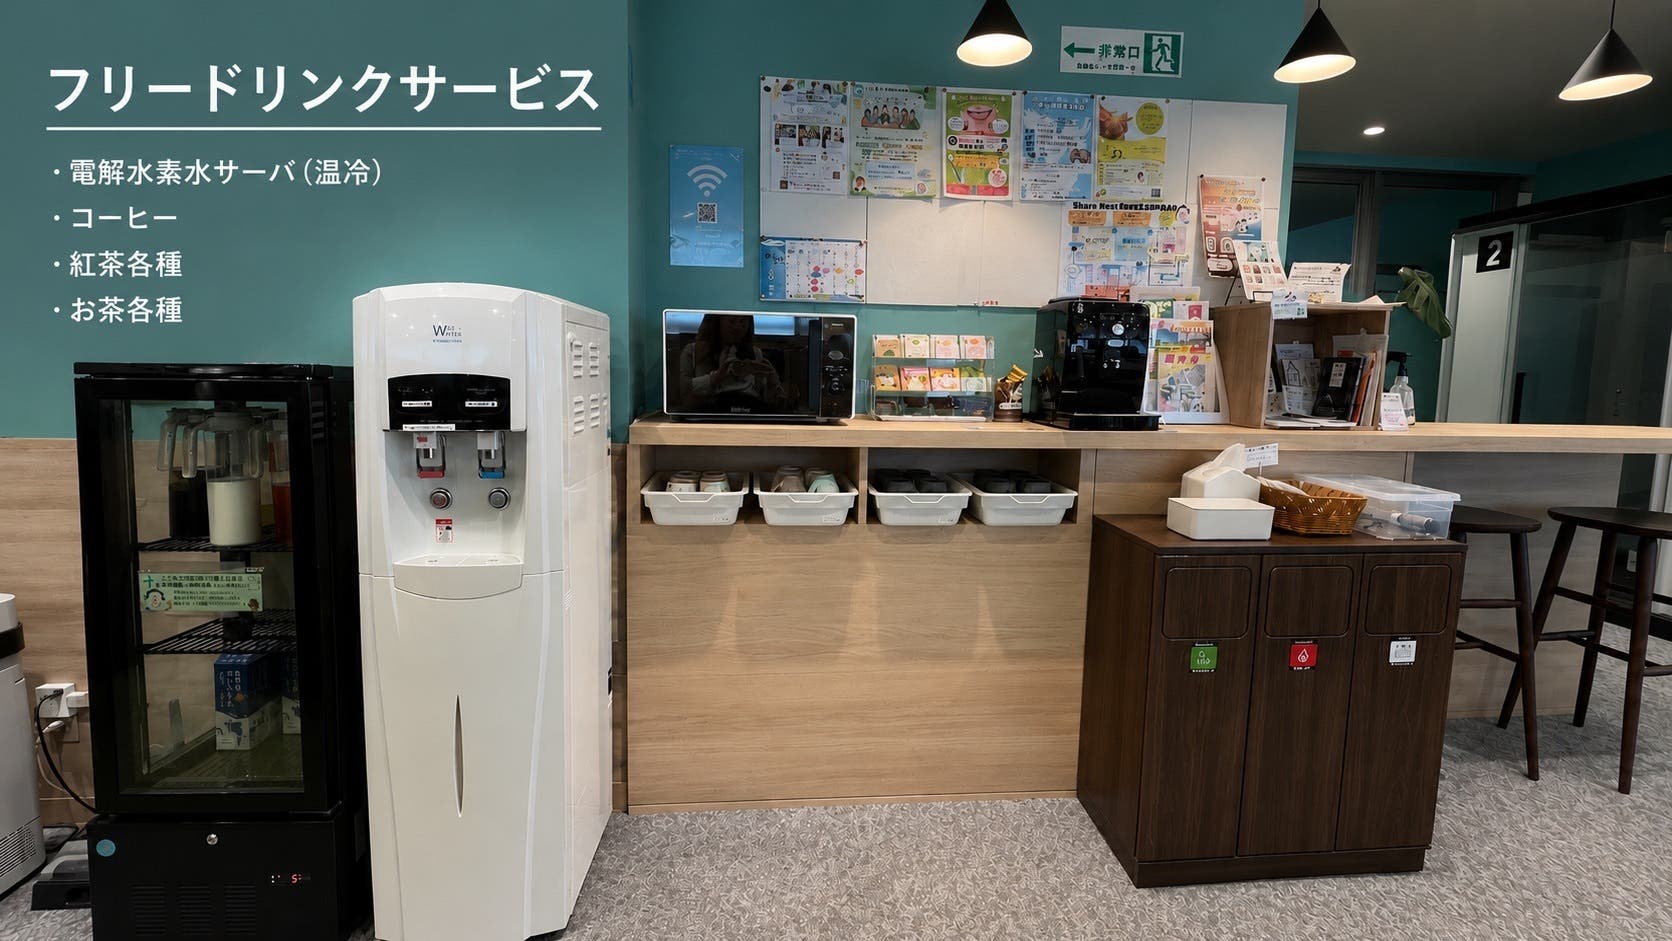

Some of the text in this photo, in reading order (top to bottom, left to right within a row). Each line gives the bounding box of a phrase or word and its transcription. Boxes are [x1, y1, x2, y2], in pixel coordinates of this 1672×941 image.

[1098, 43, 1140, 59] 非常口
[1486, 239, 1502, 267] 2
